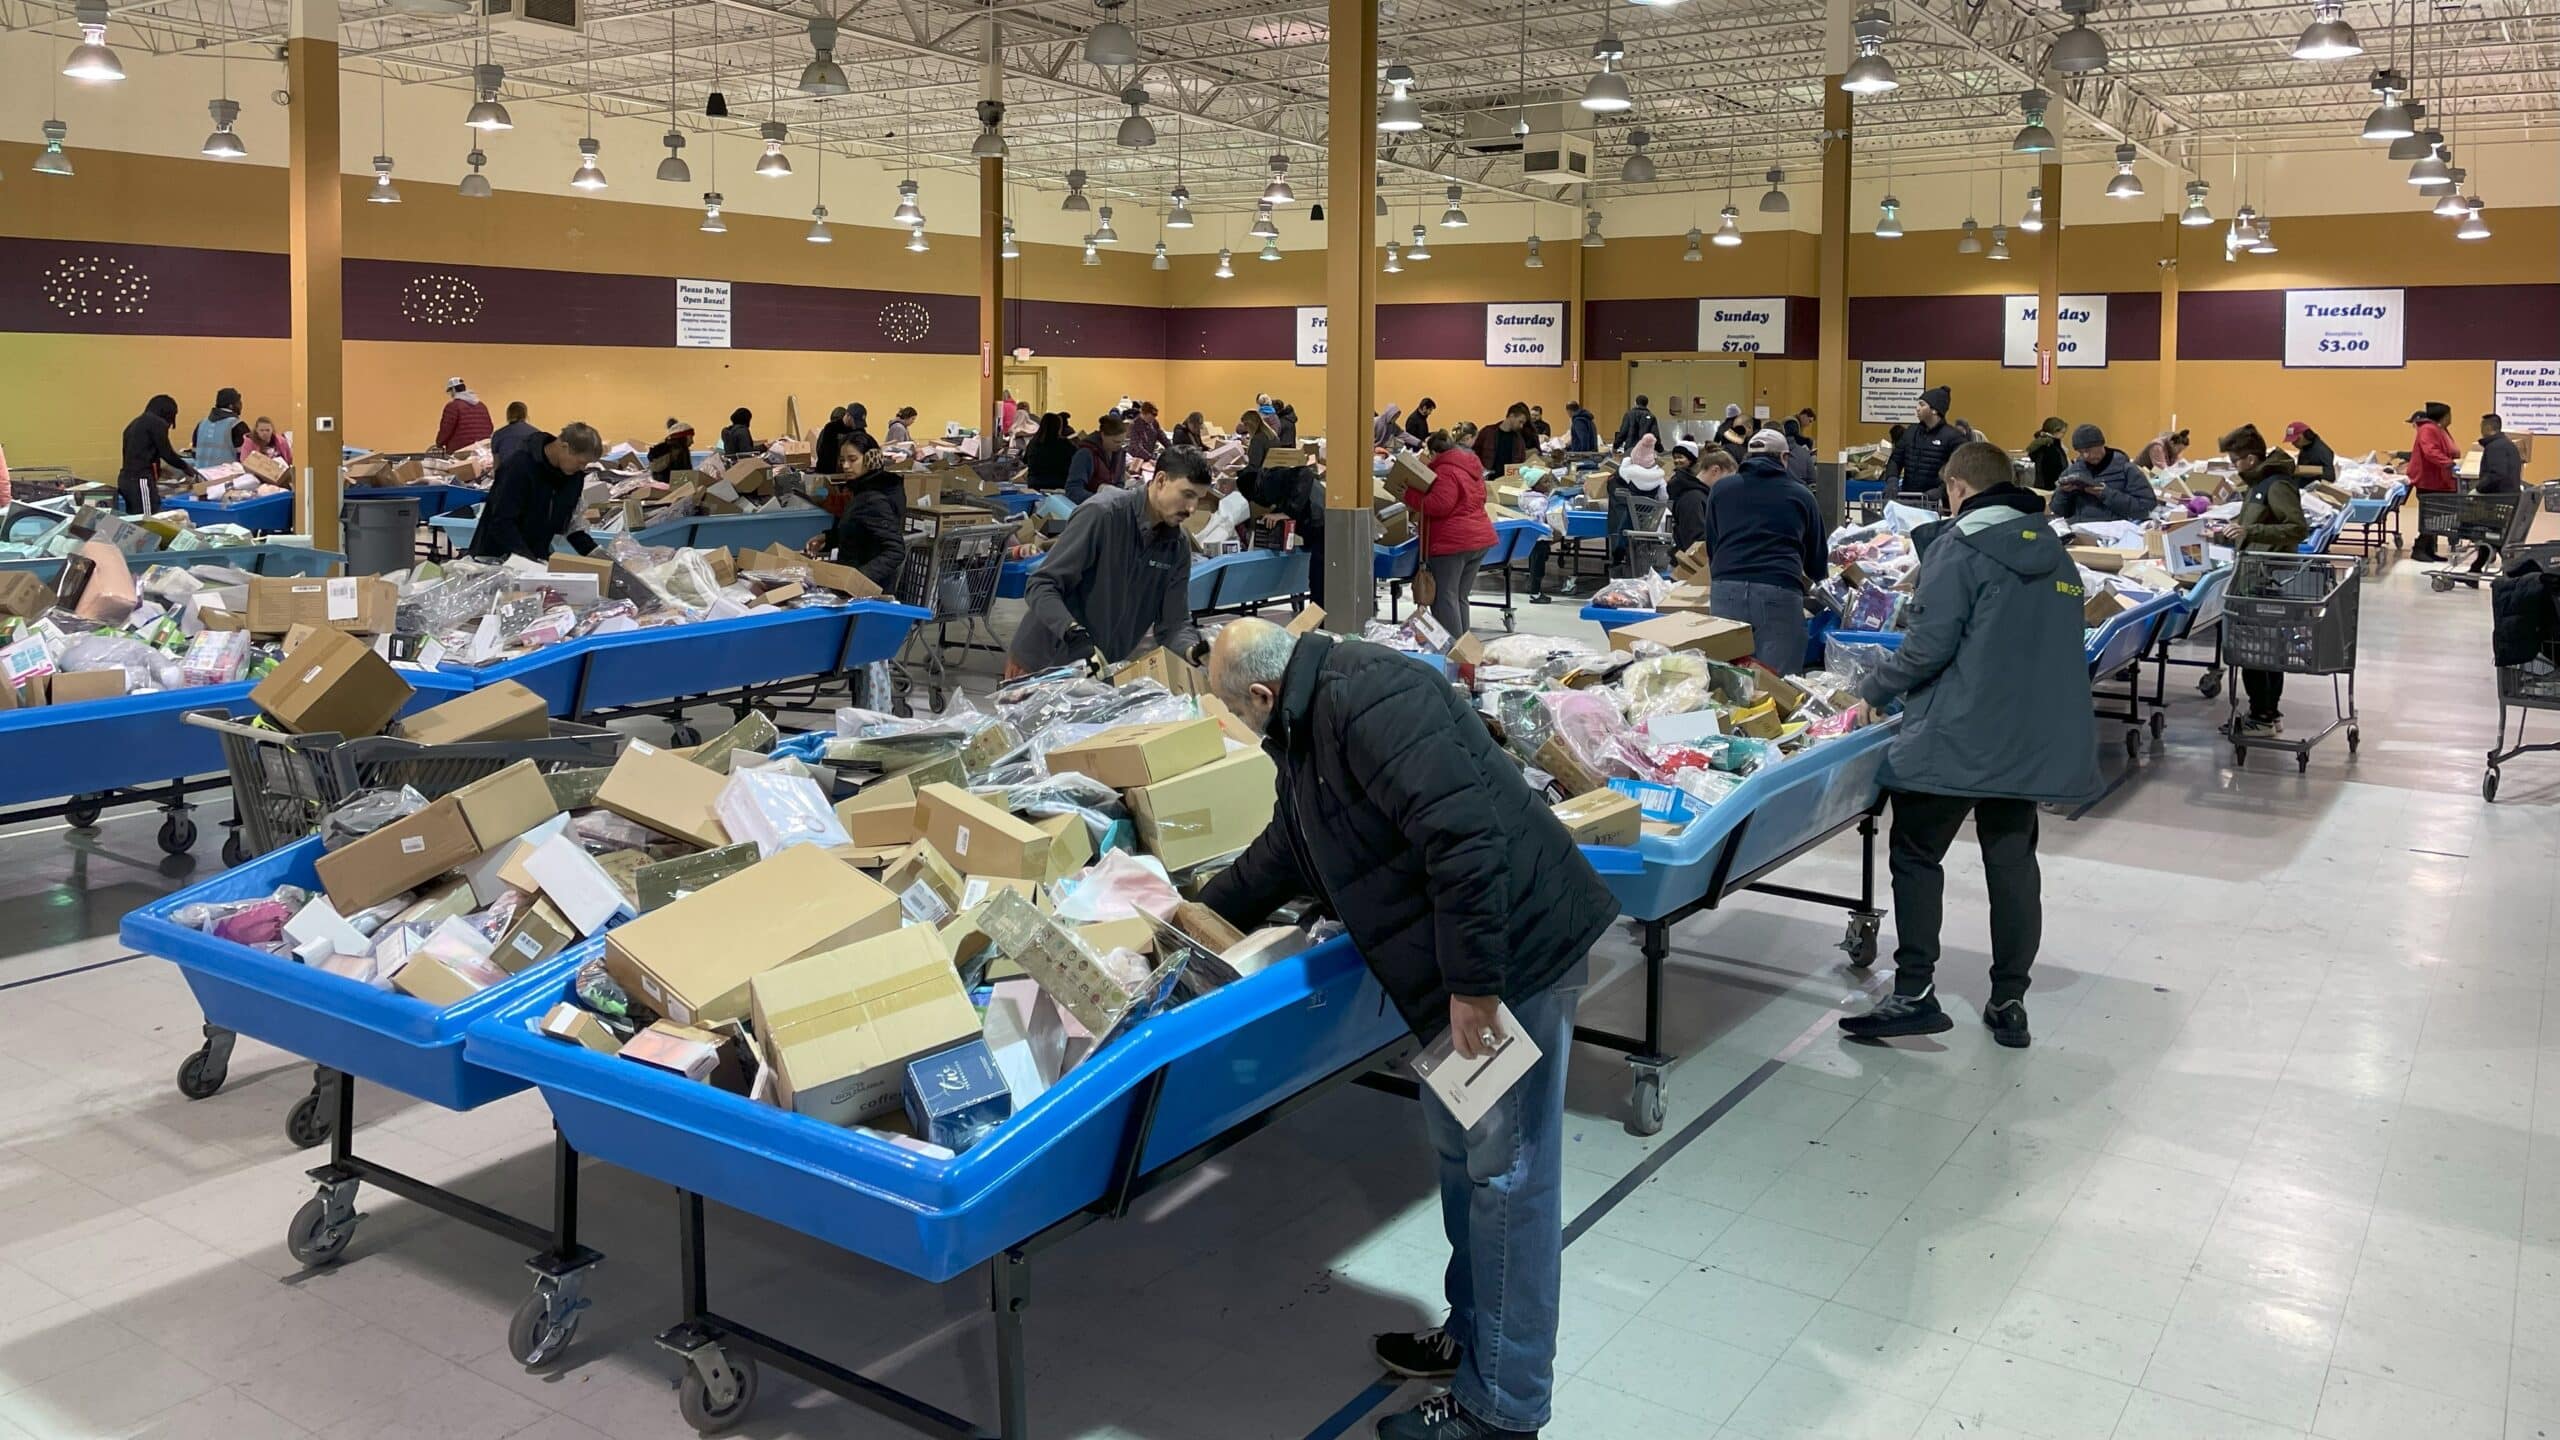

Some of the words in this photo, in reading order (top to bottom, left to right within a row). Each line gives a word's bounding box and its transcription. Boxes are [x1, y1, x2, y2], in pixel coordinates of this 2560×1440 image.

[680, 285, 703, 294] Please
[704, 286, 714, 294] Do
[715, 287, 729, 295] Not
[683, 295, 702, 305] Open
[703, 296, 726, 305] Boxes!
[1714, 310, 1770, 324] Sunday
[2022, 308, 2090, 323] Mday
[2304, 303, 2387, 320] Tuesday
[1495, 314, 1555, 328] Saturday
[1504, 343, 1545, 354] $10.00
[1722, 340, 1760, 352] $7.00
[2318, 339, 2370, 353] $3.00
[2501, 367, 2537, 376] Please
[2540, 367, 2555, 376] Do
[1869, 376, 1890, 384] Open
[1892, 376, 1919, 384] Boxes!
[2506, 378, 2534, 388] Open
